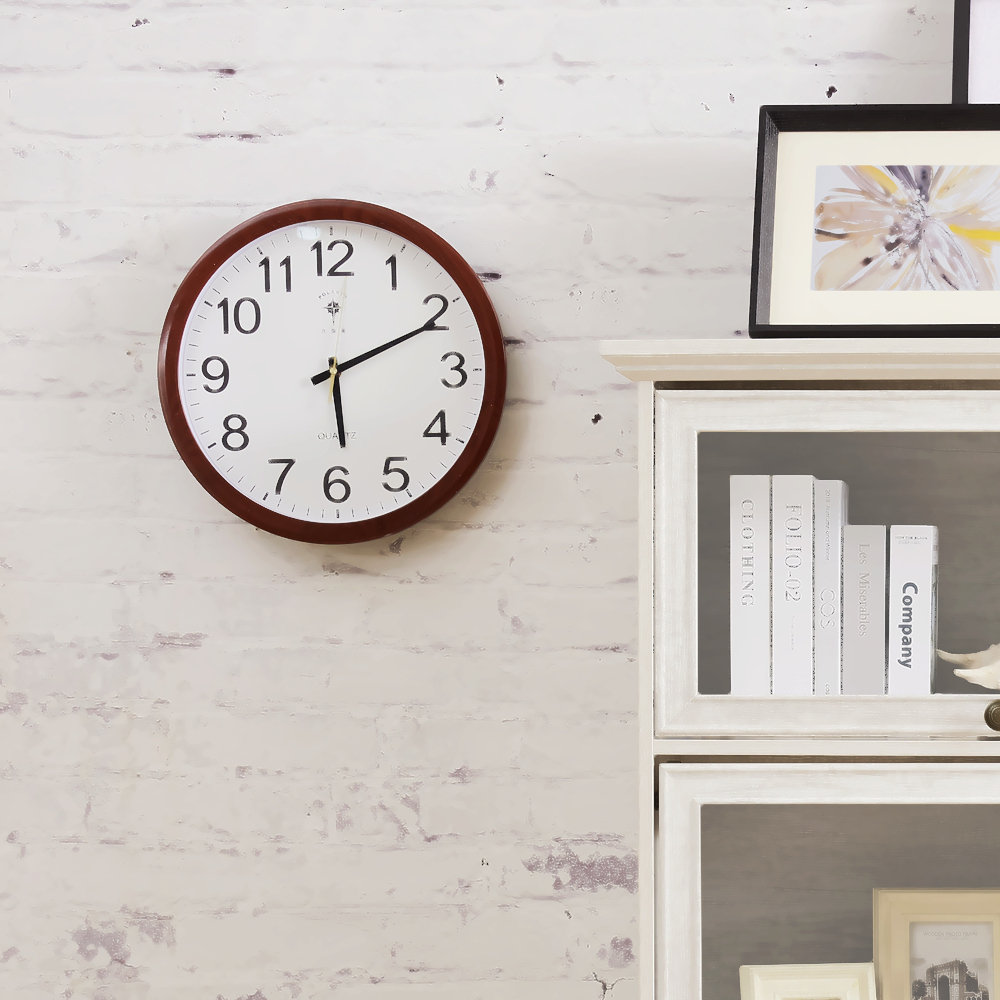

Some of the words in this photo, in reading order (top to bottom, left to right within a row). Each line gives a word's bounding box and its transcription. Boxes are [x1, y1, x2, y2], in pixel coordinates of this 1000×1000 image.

[258, 255, 292, 293] 11
[310, 239, 354, 277] 12
[385, 254, 397, 291] 1
[217, 296, 261, 334] 10
[422, 293, 449, 330] 2
[201, 355, 230, 394] 9
[440, 351, 468, 389] 3
[221, 413, 250, 452] 8
[317, 431, 358, 440] QUATZ
[422, 409, 451, 446] 4
[268, 458, 296, 495] 7
[322, 465, 351, 504] 6
[382, 456, 410, 492] 5
[741, 499, 755, 606] CLOTHING
[819, 589, 835, 629] COS
[898, 581, 919, 669] Company
